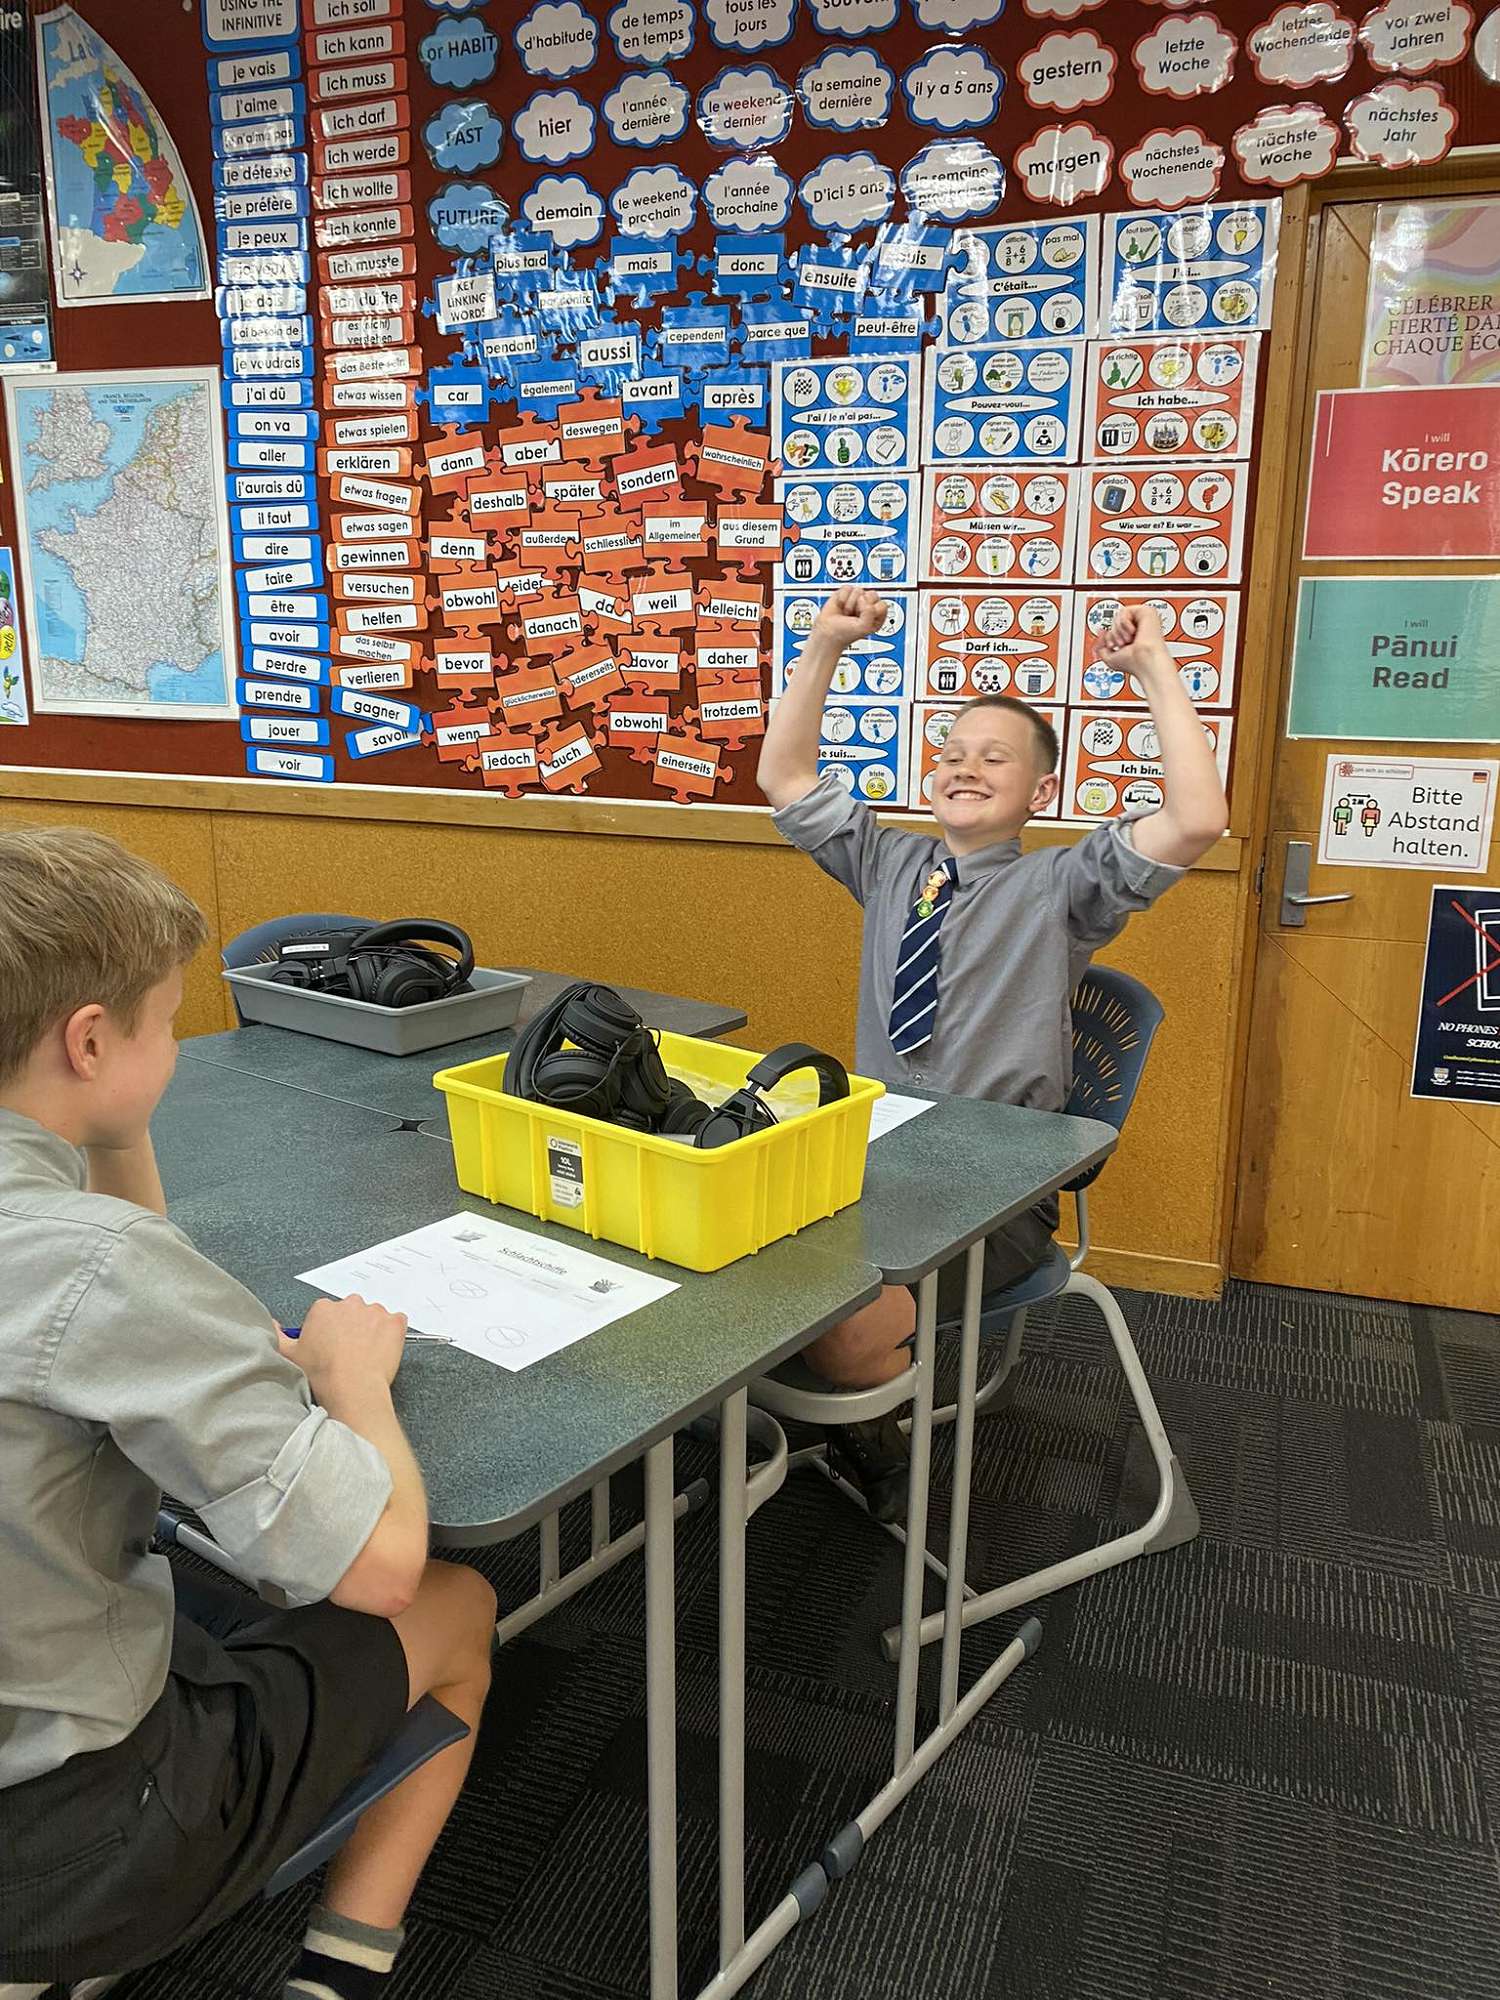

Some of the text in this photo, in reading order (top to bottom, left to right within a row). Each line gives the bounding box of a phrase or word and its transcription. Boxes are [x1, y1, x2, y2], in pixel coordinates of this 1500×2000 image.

[220, 0, 256, 11] USING
[725, 0, 777, 14] tous les
[222, 14, 282, 31] INFINITIVE
[622, 8, 684, 29] de temps
[1281, 16, 1323, 32] letztes
[1385, 8, 1451, 30] vor zwei
[734, 20, 768, 36] jours
[324, 35, 384, 55] ich kann
[524, 29, 593, 50] d'habitude
[623, 28, 684, 49] en temps
[1165, 38, 1205, 54] letzte
[1389, 31, 1445, 51] Jahren
[427, 35, 496, 62] or HABIT
[1033, 60, 1102, 85] gestern
[1158, 57, 1210, 74] Woche
[811, 76, 882, 92] la semaine
[236, 97, 277, 117] j'aime
[622, 95, 668, 113] l'année
[709, 93, 781, 113] le weekend
[818, 94, 873, 110] dernière
[621, 113, 671, 131] dernière
[723, 115, 767, 129] dernier
[1368, 108, 1440, 123] nächstes
[538, 118, 572, 138] hier
[1382, 127, 1418, 142] Jahr
[1257, 130, 1318, 148] nächste
[1145, 144, 1200, 162] nächstes
[1259, 149, 1313, 167] Woche
[1028, 151, 1101, 177] morgen
[1132, 158, 1214, 180] Wochenende
[327, 179, 393, 199] ich wollte
[724, 181, 770, 198] l'année
[813, 181, 885, 204] D'ici 5 ans
[229, 194, 293, 216] je préfère
[618, 186, 688, 211] le weekend
[437, 209, 499, 226] FUTURE
[535, 203, 593, 221] demain
[628, 206, 681, 227] prochain
[716, 200, 779, 219] prochaine
[627, 259, 658, 272] mais
[730, 260, 766, 273] donc
[457, 280, 475, 292] KEY
[804, 272, 858, 289] ensuite
[993, 281, 1038, 293] C'était...
[447, 293, 487, 308] LINKING
[1387, 295, 1493, 316] CÉLÉBRER
[748, 326, 807, 340] parce que
[857, 321, 916, 336] peut-être
[1388, 316, 1460, 335] FIERTÉ
[485, 339, 536, 355] pendant
[587, 341, 632, 362] aussi
[1373, 335, 1463, 357] CHAQUE
[337, 390, 402, 401] etwas wissen
[448, 390, 470, 402] car
[523, 383, 574, 396] également
[629, 382, 674, 398] avant
[711, 387, 756, 407] après
[971, 400, 1031, 410] Pouvez-vous...
[1137, 395, 1199, 406] Ich habe...
[566, 422, 619, 438] deswegen
[1430, 433, 1451, 443] will
[259, 449, 286, 462] aller
[514, 446, 548, 461] aber
[704, 448, 763, 469] wahrscheinlich
[1381, 446, 1489, 473] Kōrero
[336, 454, 390, 470] erklären
[440, 455, 474, 472] dann
[238, 479, 302, 496] j'aurais dû
[620, 469, 676, 491] sondern
[553, 485, 596, 500] später
[1381, 480, 1481, 510] Speak
[473, 493, 525, 510] deshalb
[722, 521, 778, 532] aus diesem
[1119, 521, 1134, 529] Wie
[1167, 521, 1174, 529] Es
[734, 534, 766, 546] Grund
[823, 528, 866, 541] Je peux...
[264, 542, 289, 556] dire
[440, 543, 475, 557] denn
[341, 550, 405, 567] gewinnen
[265, 571, 293, 586] faire
[347, 581, 409, 596] versuchen
[270, 599, 295, 614] être
[445, 592, 496, 608] obwohl
[648, 595, 678, 611] weil
[361, 611, 402, 627] helfen
[528, 618, 579, 636] danach
[1410, 620, 1429, 629] will
[269, 629, 300, 643] avoir
[966, 641, 1018, 652] Darf ich...
[1371, 635, 1459, 659] Pānui
[265, 657, 307, 675] perdre
[444, 657, 484, 669] bevor
[630, 656, 669, 669] davor
[707, 652, 748, 665] daher
[347, 670, 400, 685] verlieren
[1372, 666, 1450, 690] Read
[254, 688, 302, 704] prendre
[504, 689, 557, 707] glücklicherweise
[353, 700, 400, 721] gagner
[703, 703, 759, 719] trotzdem
[268, 723, 300, 738] jouer
[614, 716, 663, 730] obwohl
[447, 728, 481, 742] wenn
[278, 759, 301, 771] voir
[487, 752, 531, 769] jedoch
[661, 754, 712, 776] einerseits
[1121, 764, 1136, 774] Ich
[1412, 786, 1463, 806] Bitte
[1388, 811, 1480, 833] Abstand
[1393, 836, 1469, 858] halten.
[1438, 1022, 1499, 1034] NO PHONES
